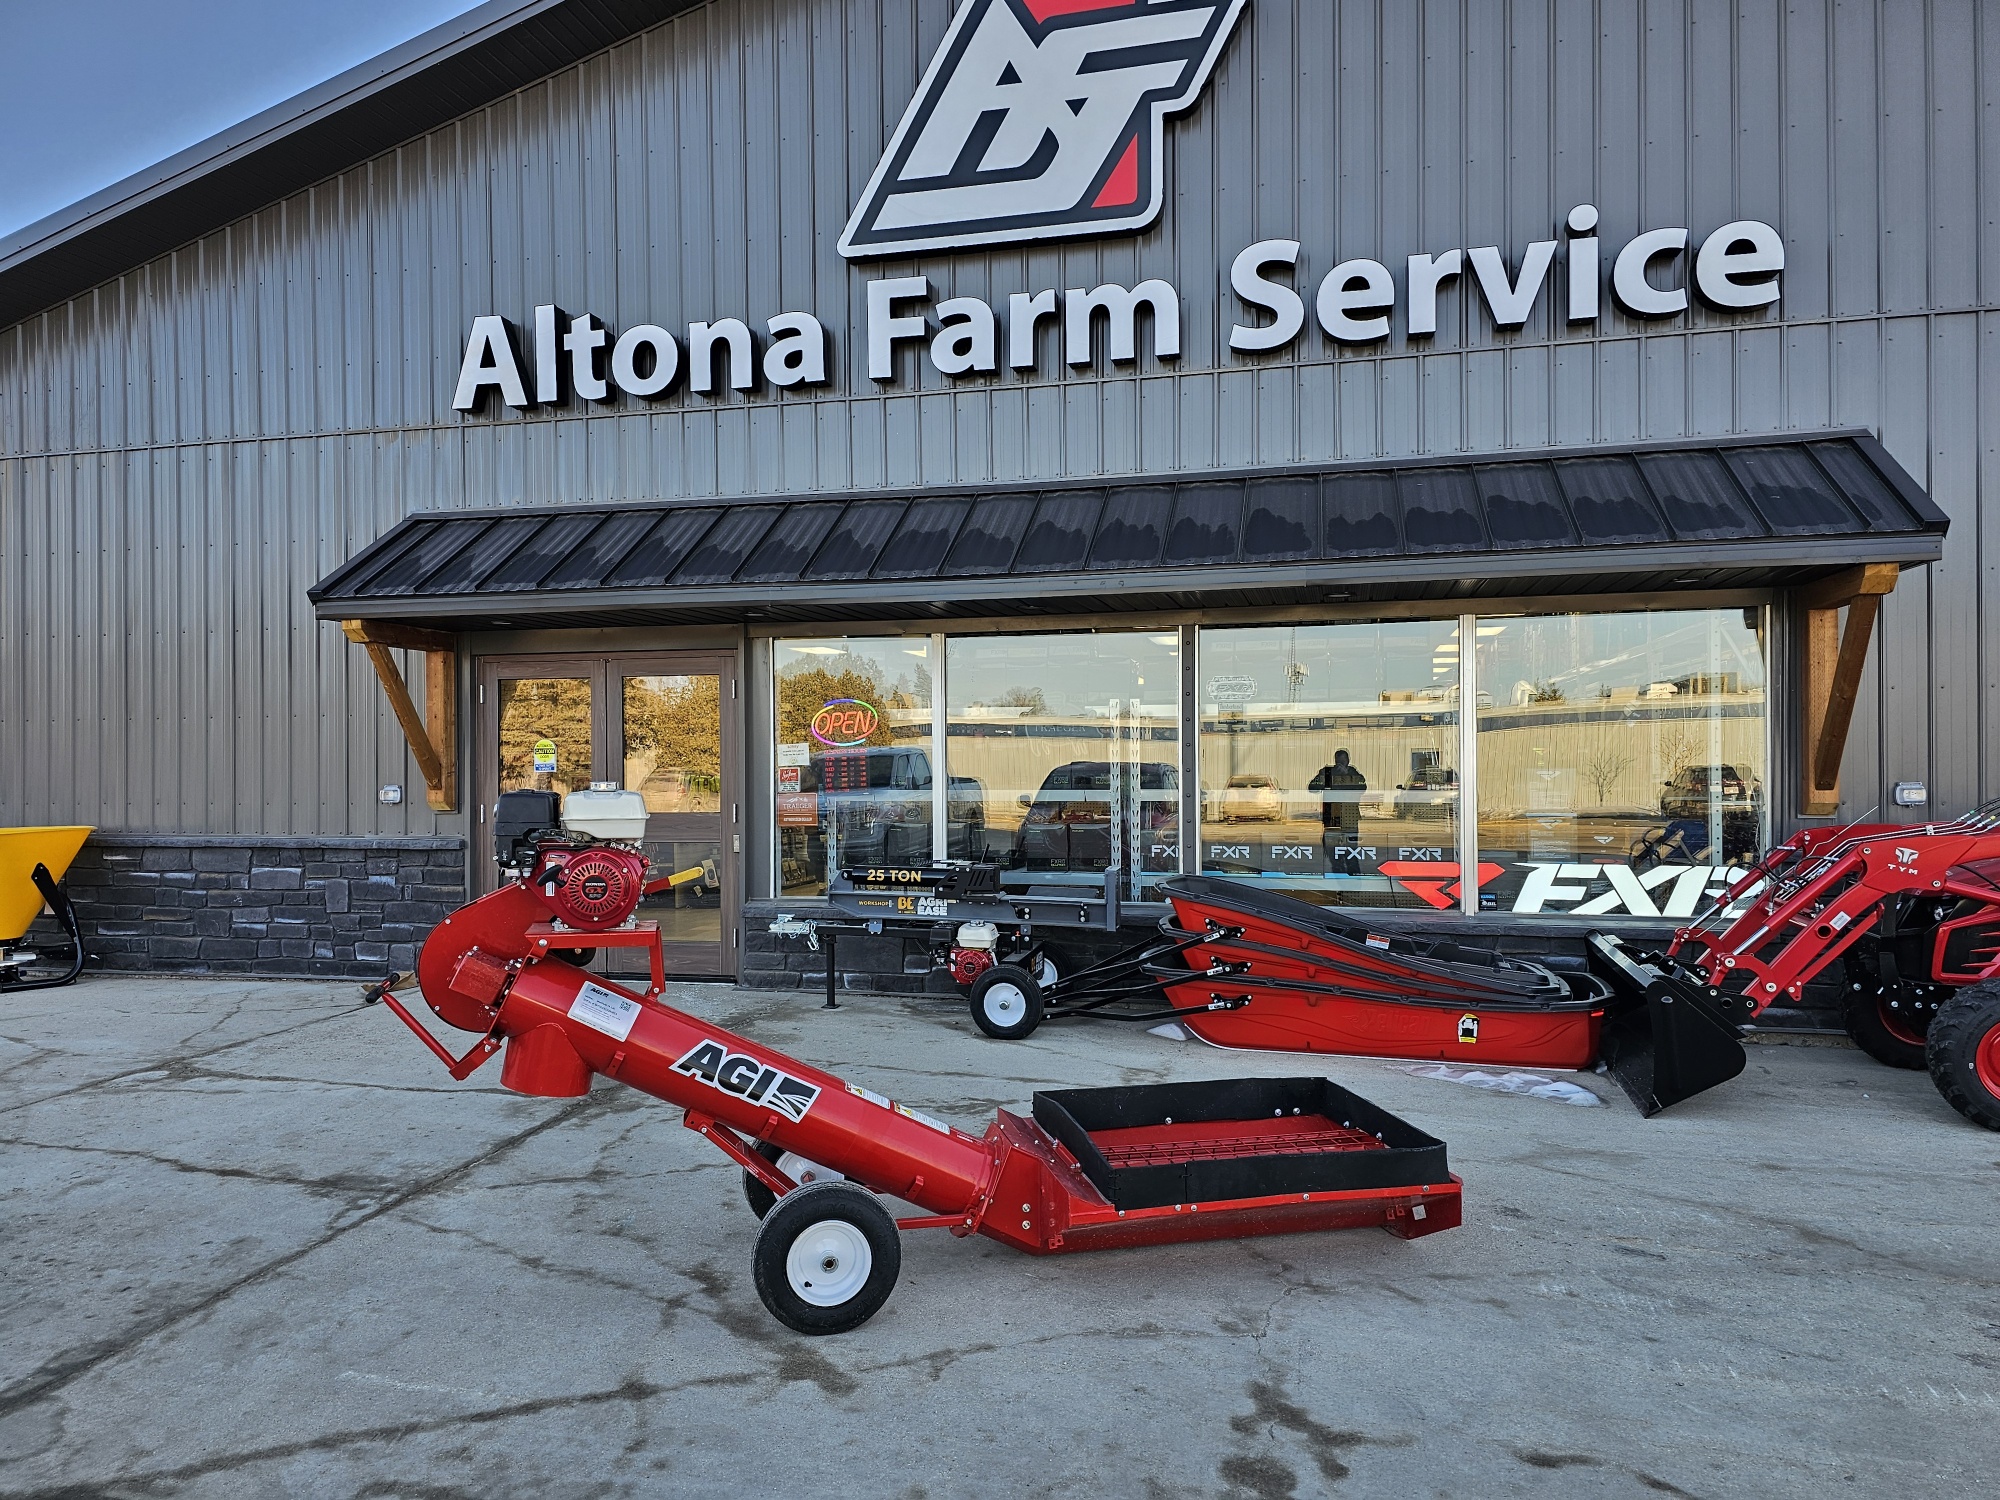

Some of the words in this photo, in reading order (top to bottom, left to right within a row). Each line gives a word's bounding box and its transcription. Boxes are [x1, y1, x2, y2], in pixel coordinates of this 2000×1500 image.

[452, 303, 829, 413] Altona
[867, 275, 1182, 382] Farm
[1228, 203, 1786, 355] Service
[815, 710, 871, 735] OPEN
[1210, 845, 1250, 859] FXR
[1271, 845, 1313, 860] FXR
[1334, 846, 1377, 860] FXR
[1398, 847, 1442, 861] FXR
[867, 869, 885, 881] 25
[889, 869, 922, 882] TON
[1887, 863, 1919, 875] TYM
[1511, 862, 1767, 918] FXR
[897, 896, 916, 910] BE
[917, 896, 948, 907] AGRI
[917, 906, 948, 916] EASE
[677, 1042, 778, 1102] AGI
